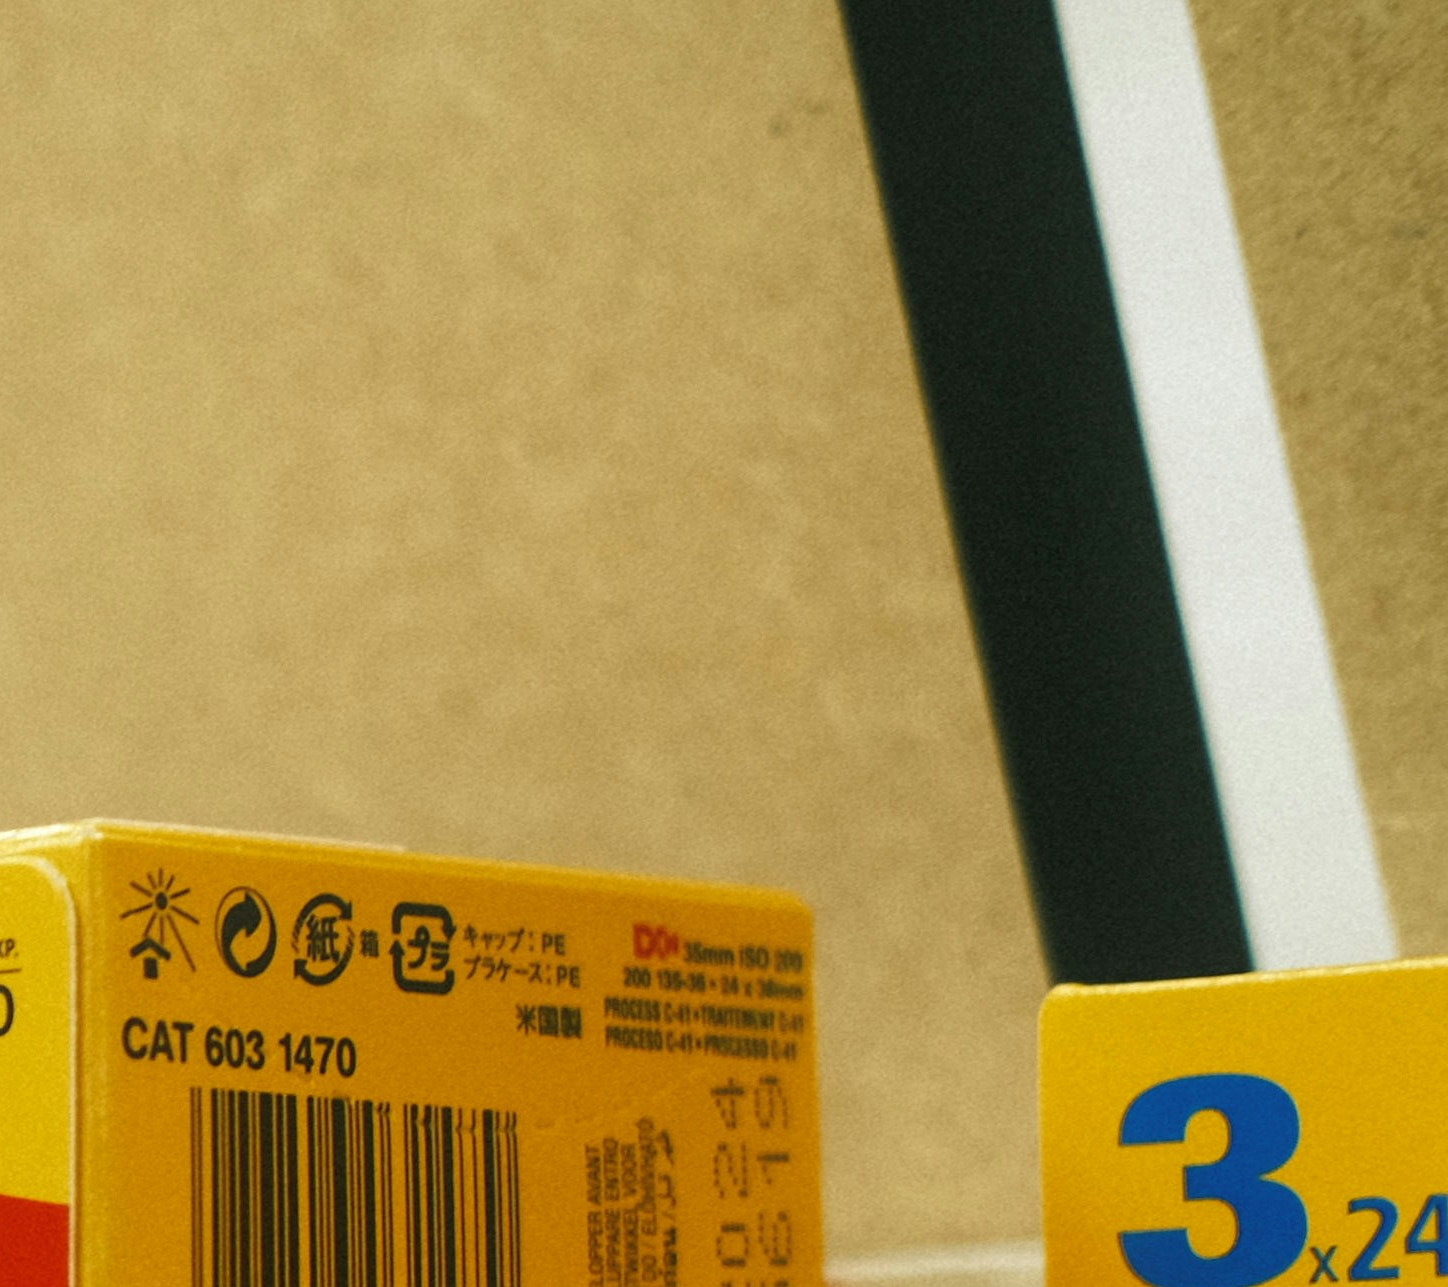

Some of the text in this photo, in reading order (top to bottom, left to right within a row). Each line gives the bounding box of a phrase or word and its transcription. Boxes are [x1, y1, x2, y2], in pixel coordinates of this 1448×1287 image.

[121, 1017, 359, 1078] CAT 603 1470
